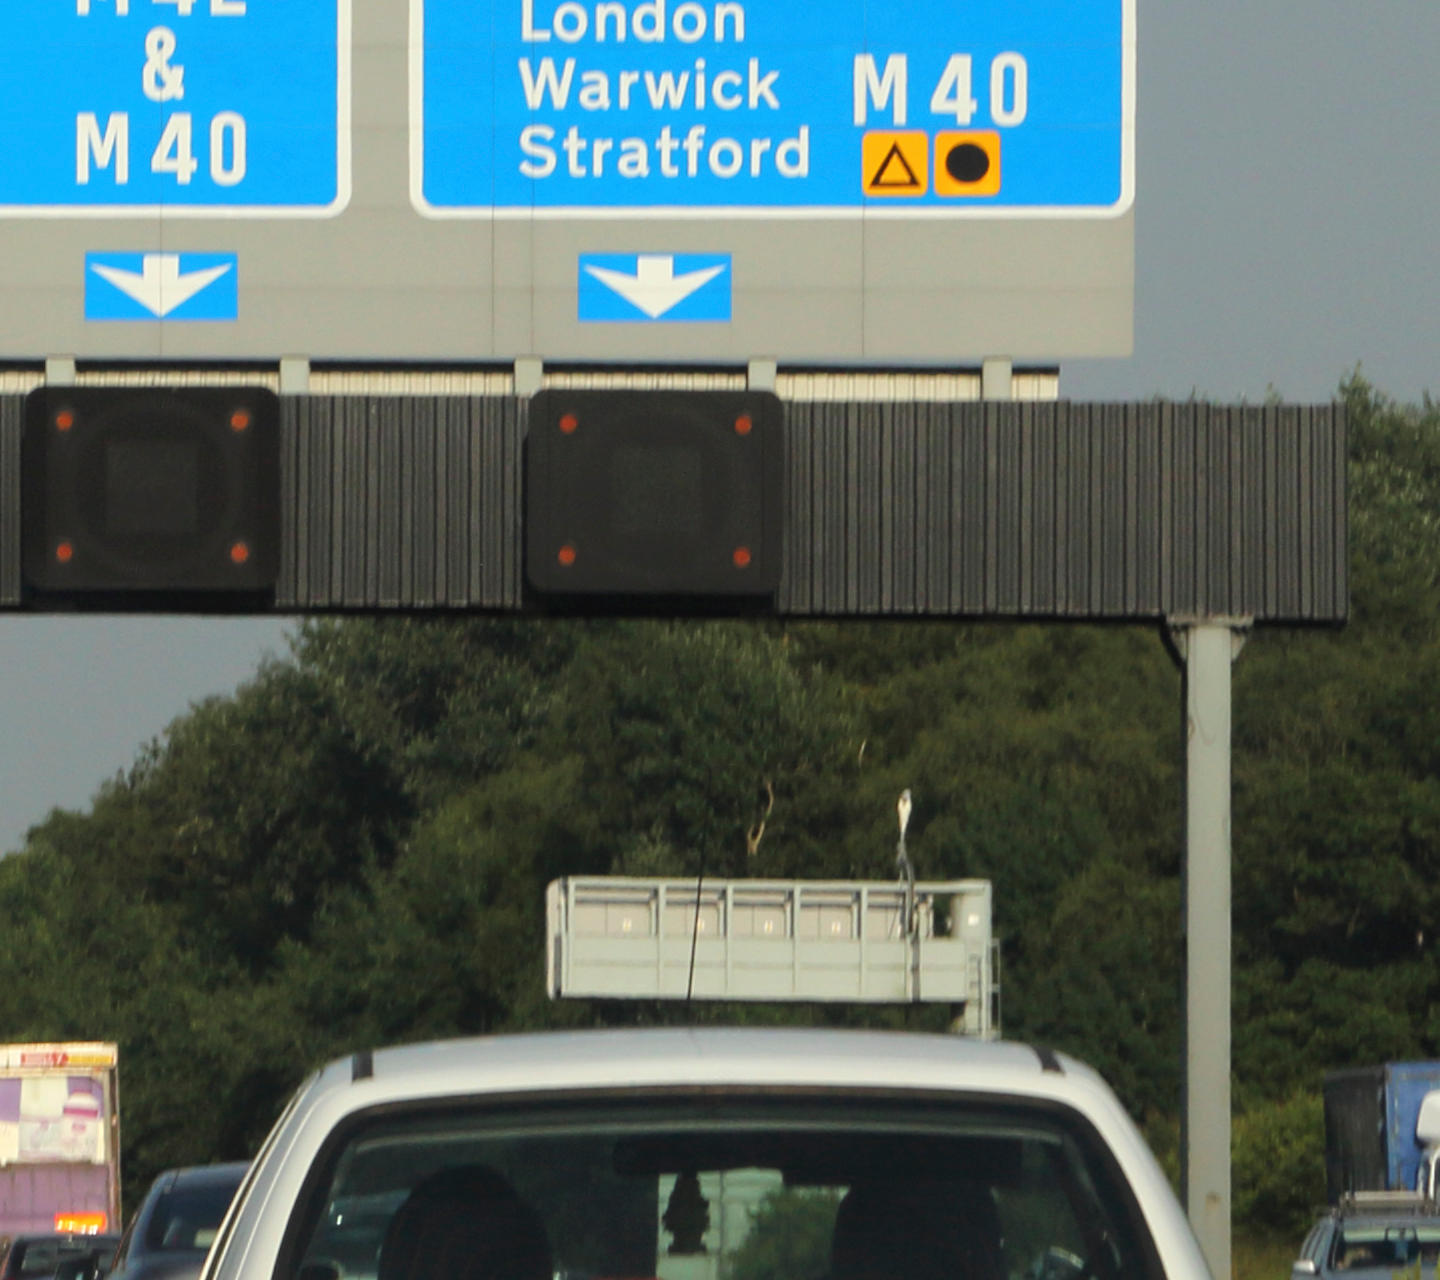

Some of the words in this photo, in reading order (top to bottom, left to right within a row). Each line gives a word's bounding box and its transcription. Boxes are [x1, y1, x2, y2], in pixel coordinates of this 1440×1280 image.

[142, 25, 186, 102] &
[519, 57, 781, 111] Warwick
[519, 124, 811, 180] Stratford
